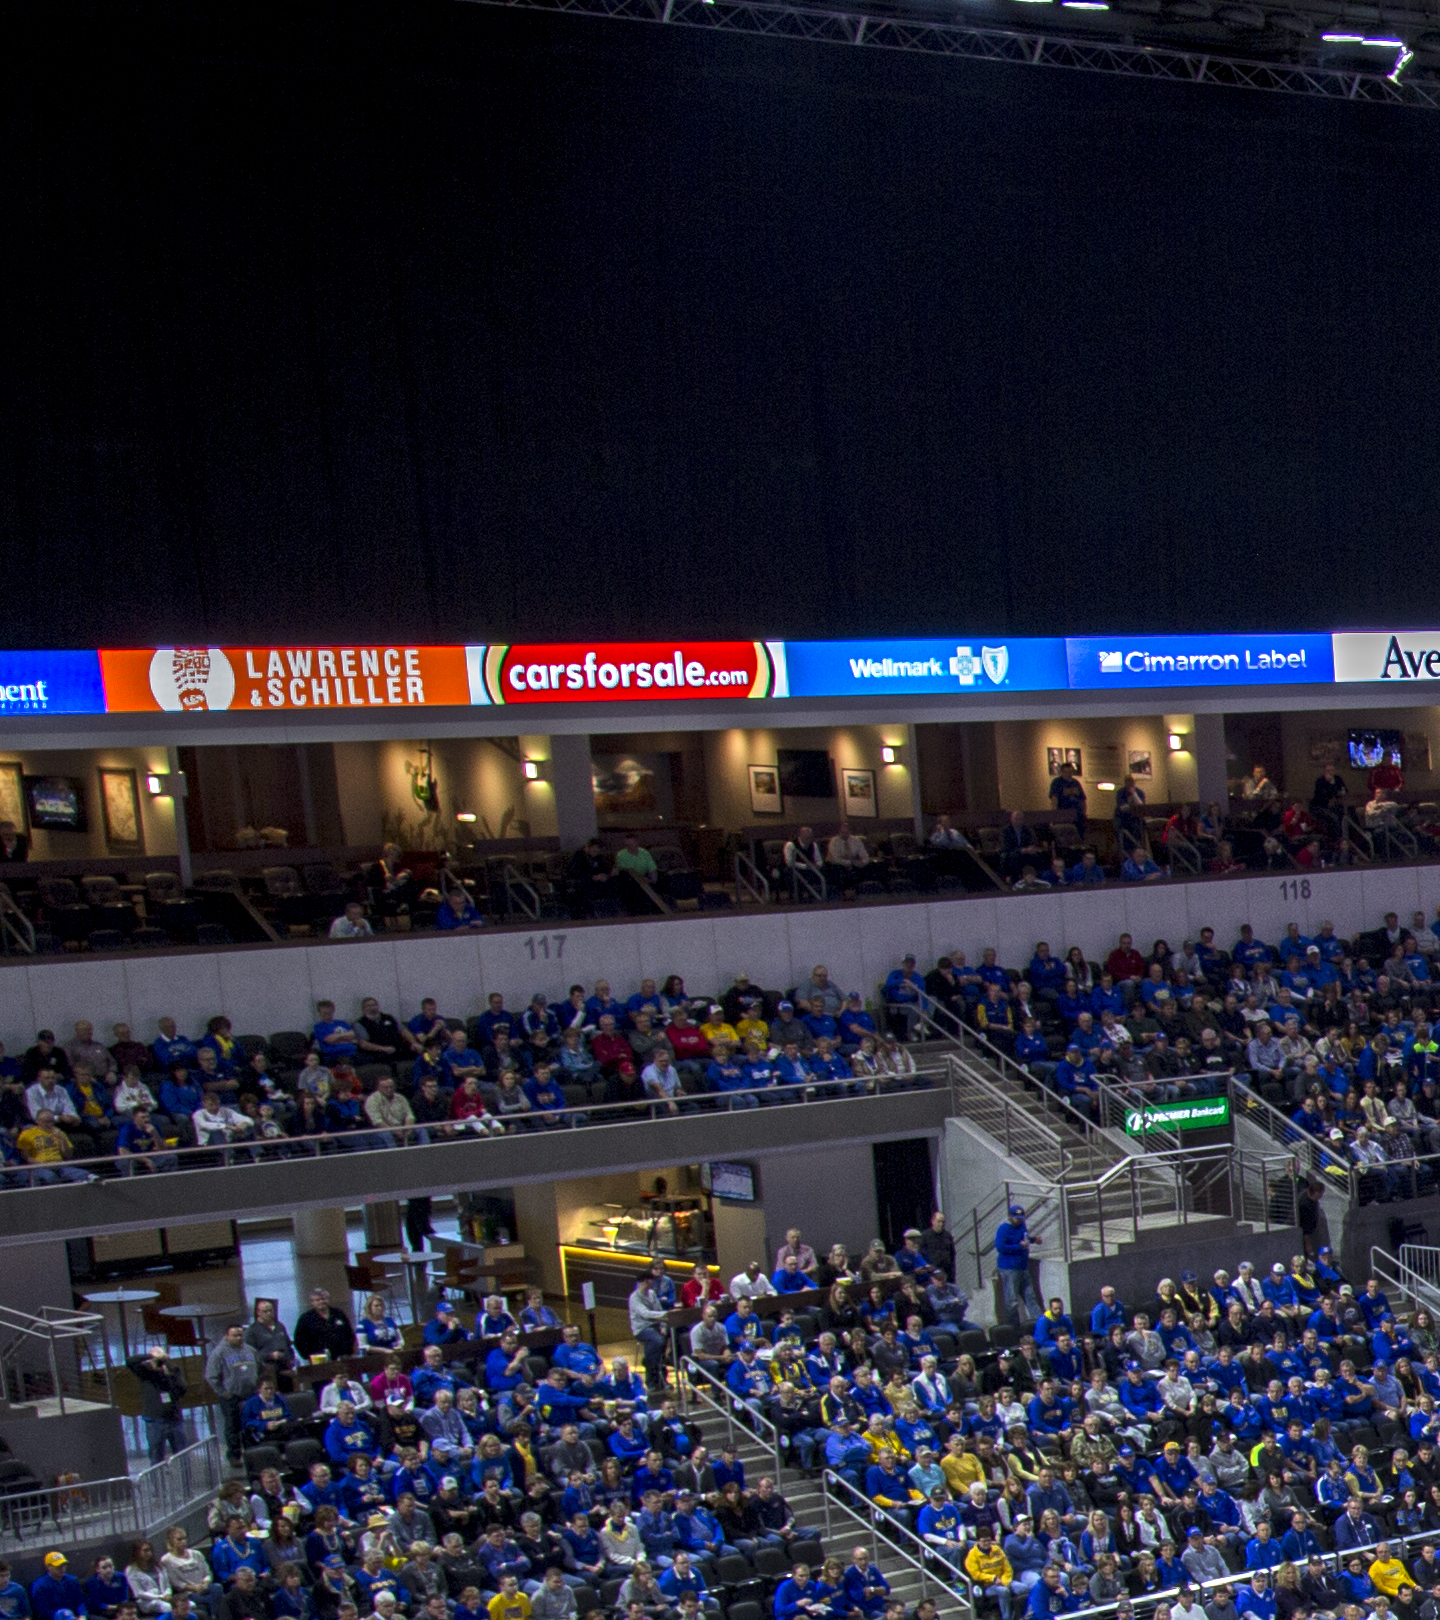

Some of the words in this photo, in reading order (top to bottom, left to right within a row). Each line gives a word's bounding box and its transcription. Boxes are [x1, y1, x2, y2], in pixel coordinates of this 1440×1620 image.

[246, 649, 420, 679] LAWRENCE
[508, 651, 749, 691] carsforsale.com
[849, 657, 942, 679] Wellmark
[1124, 650, 1240, 673] Cimarron
[1244, 649, 1308, 671] Label
[1278, 880, 1313, 902] 118
[523, 936, 567, 960] 117
